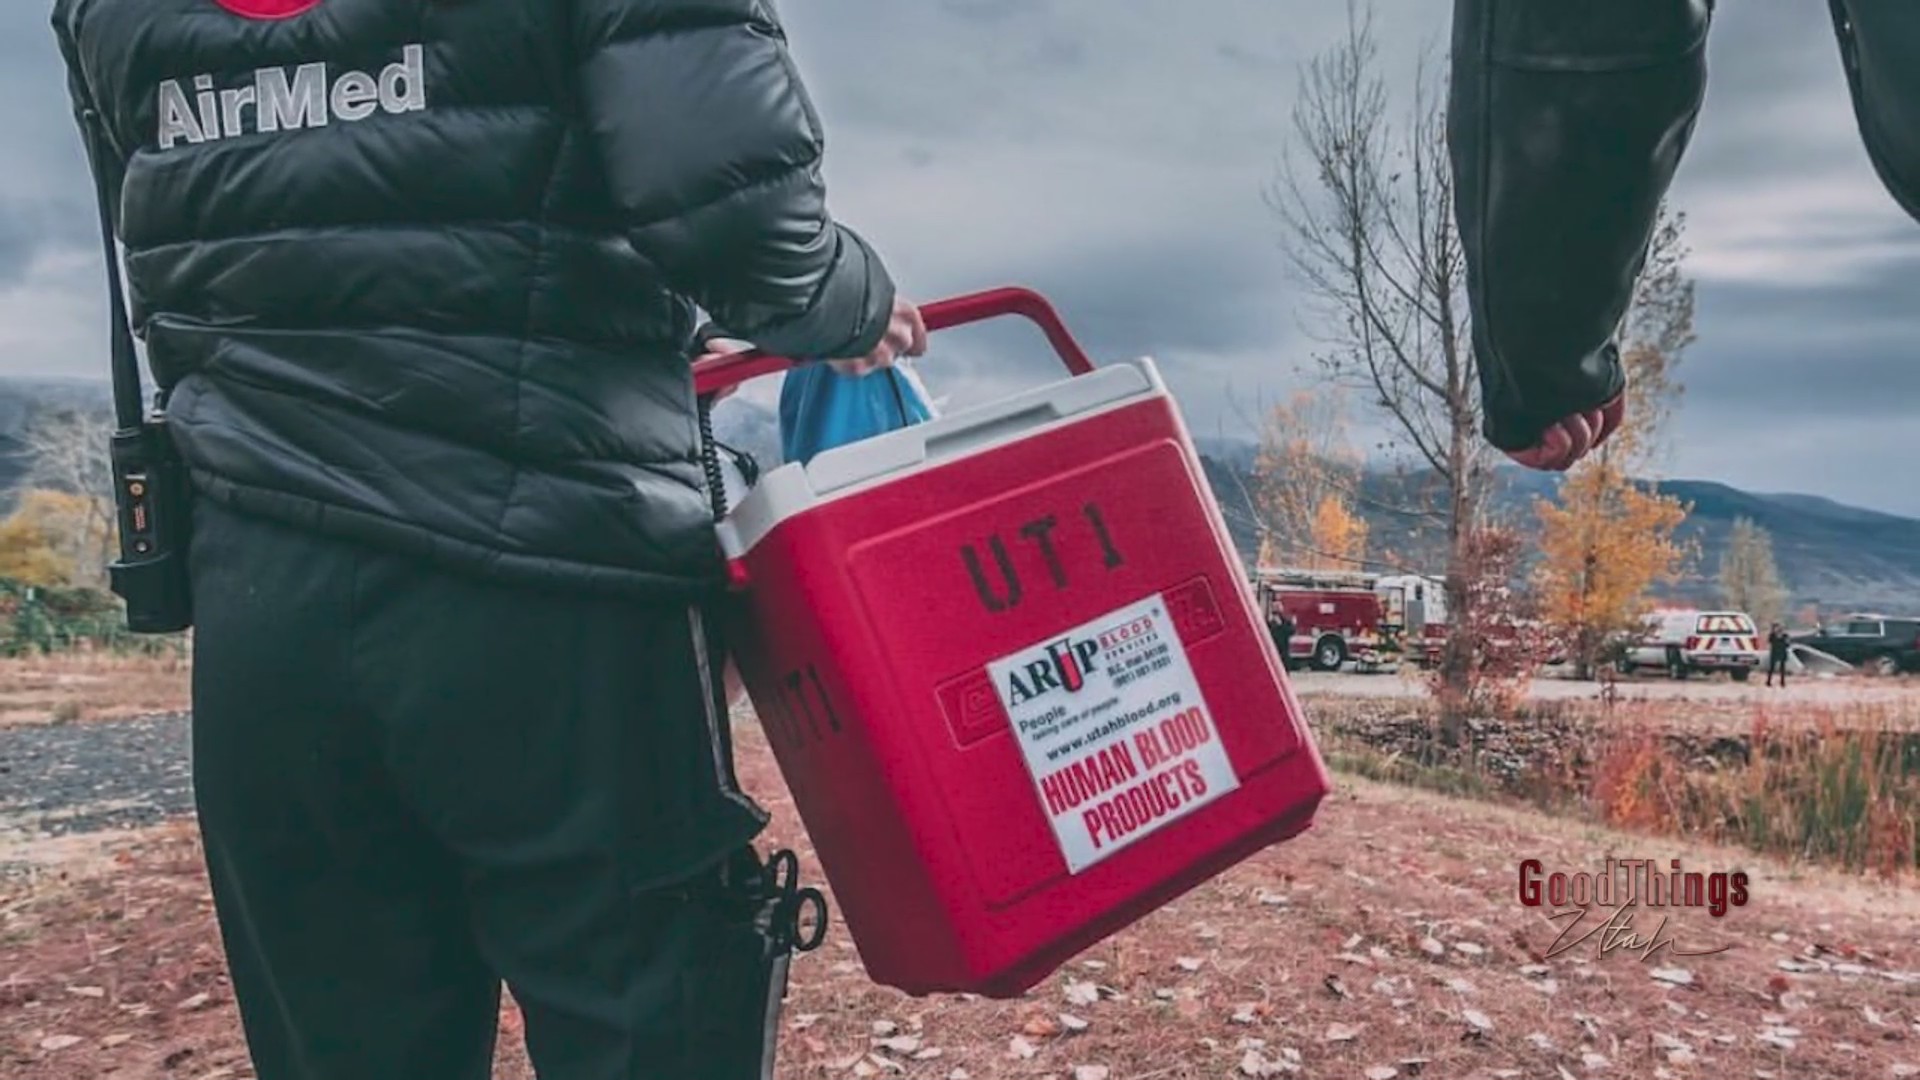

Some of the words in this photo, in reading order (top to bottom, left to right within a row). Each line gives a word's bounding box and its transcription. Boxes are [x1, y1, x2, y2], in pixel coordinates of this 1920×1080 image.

[158, 44, 426, 149] AirMed
[1100, 618, 1152, 648] BLOOD
[1008, 637, 1099, 707] ARUP
[1018, 705, 1066, 732] People
[1032, 724, 1060, 741] taking
[1060, 714, 1079, 728] care
[1091, 697, 1118, 717] people
[1046, 692, 1181, 760] www.utahblood.org
[1039, 740, 1138, 816] HUMAN
[1133, 706, 1210, 771] BLOOD
[1082, 759, 1207, 849] PRODUCTS
